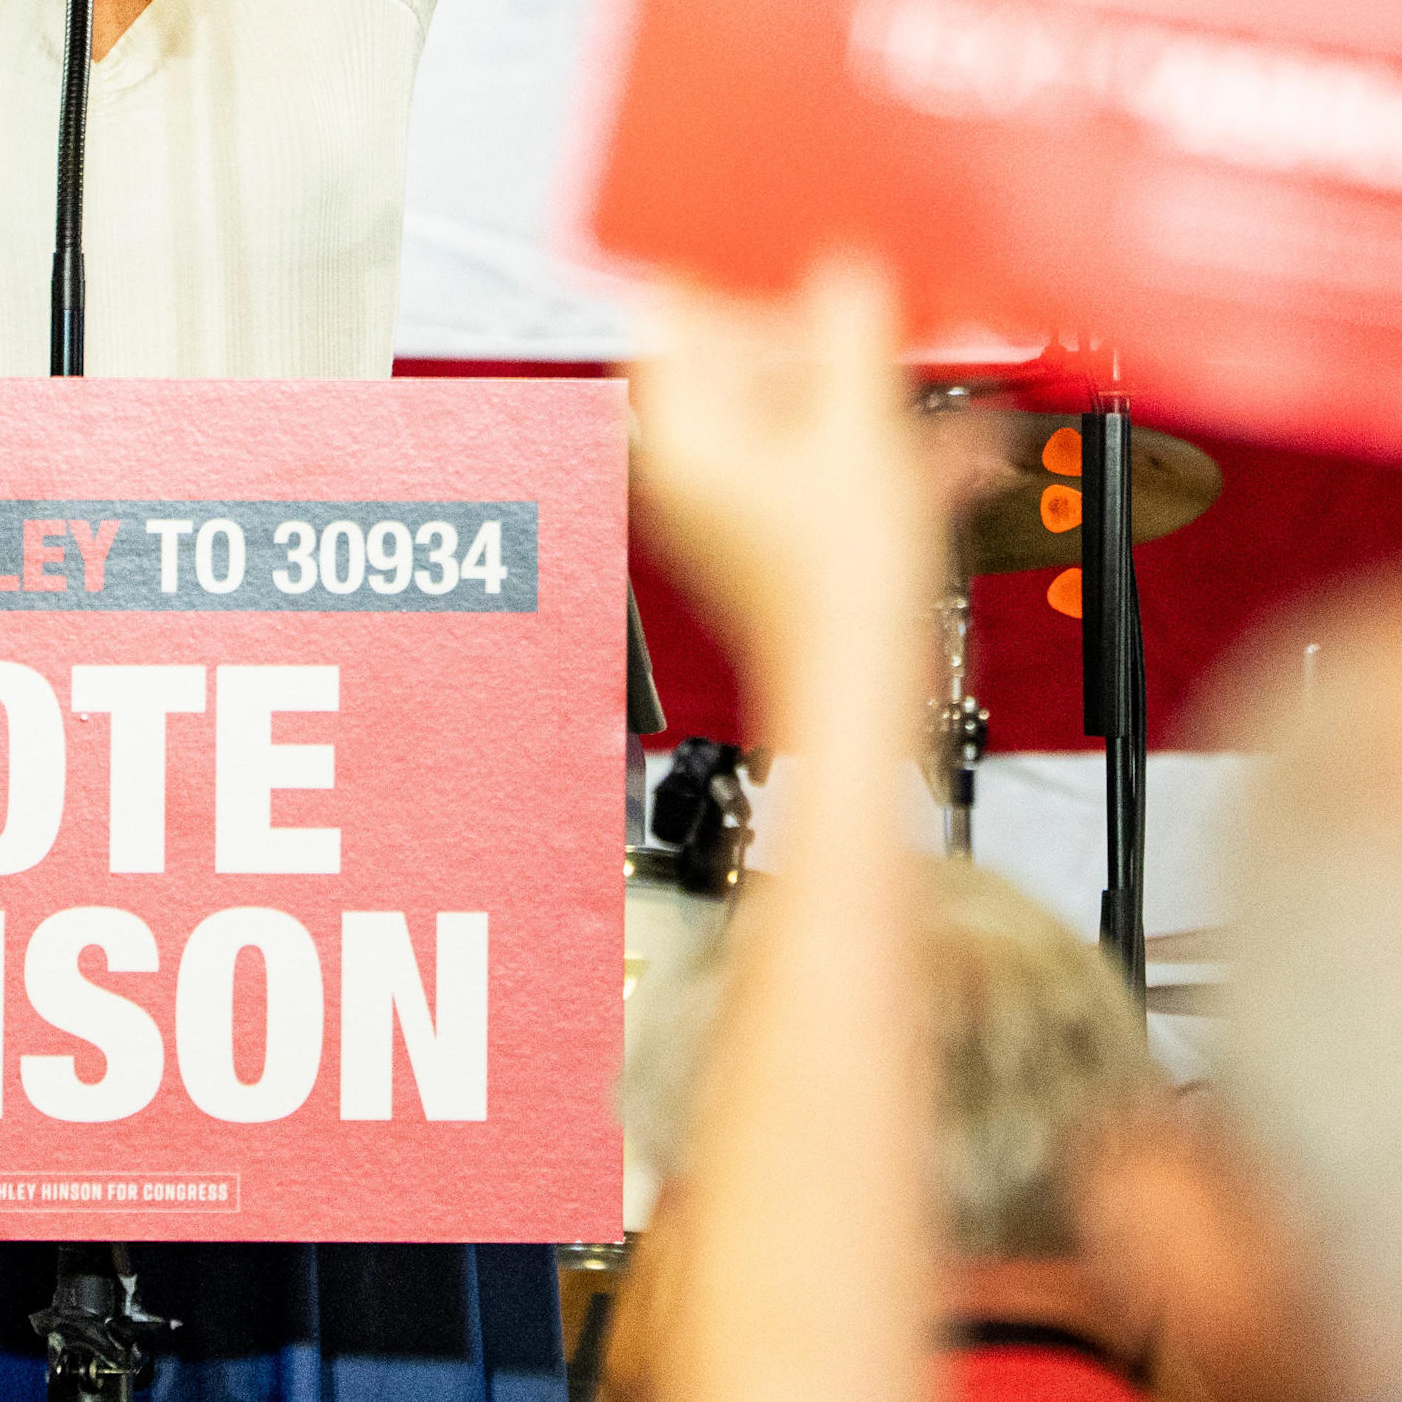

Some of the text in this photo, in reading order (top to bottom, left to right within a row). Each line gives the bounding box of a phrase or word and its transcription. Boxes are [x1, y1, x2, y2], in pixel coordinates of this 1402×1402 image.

[145, 518, 246, 594] TO
[272, 519, 508, 595] 30934
[41, 1182, 101, 1200] HINSON
[107, 1182, 138, 1200] FOR
[143, 1182, 228, 1201] CONGRESS
